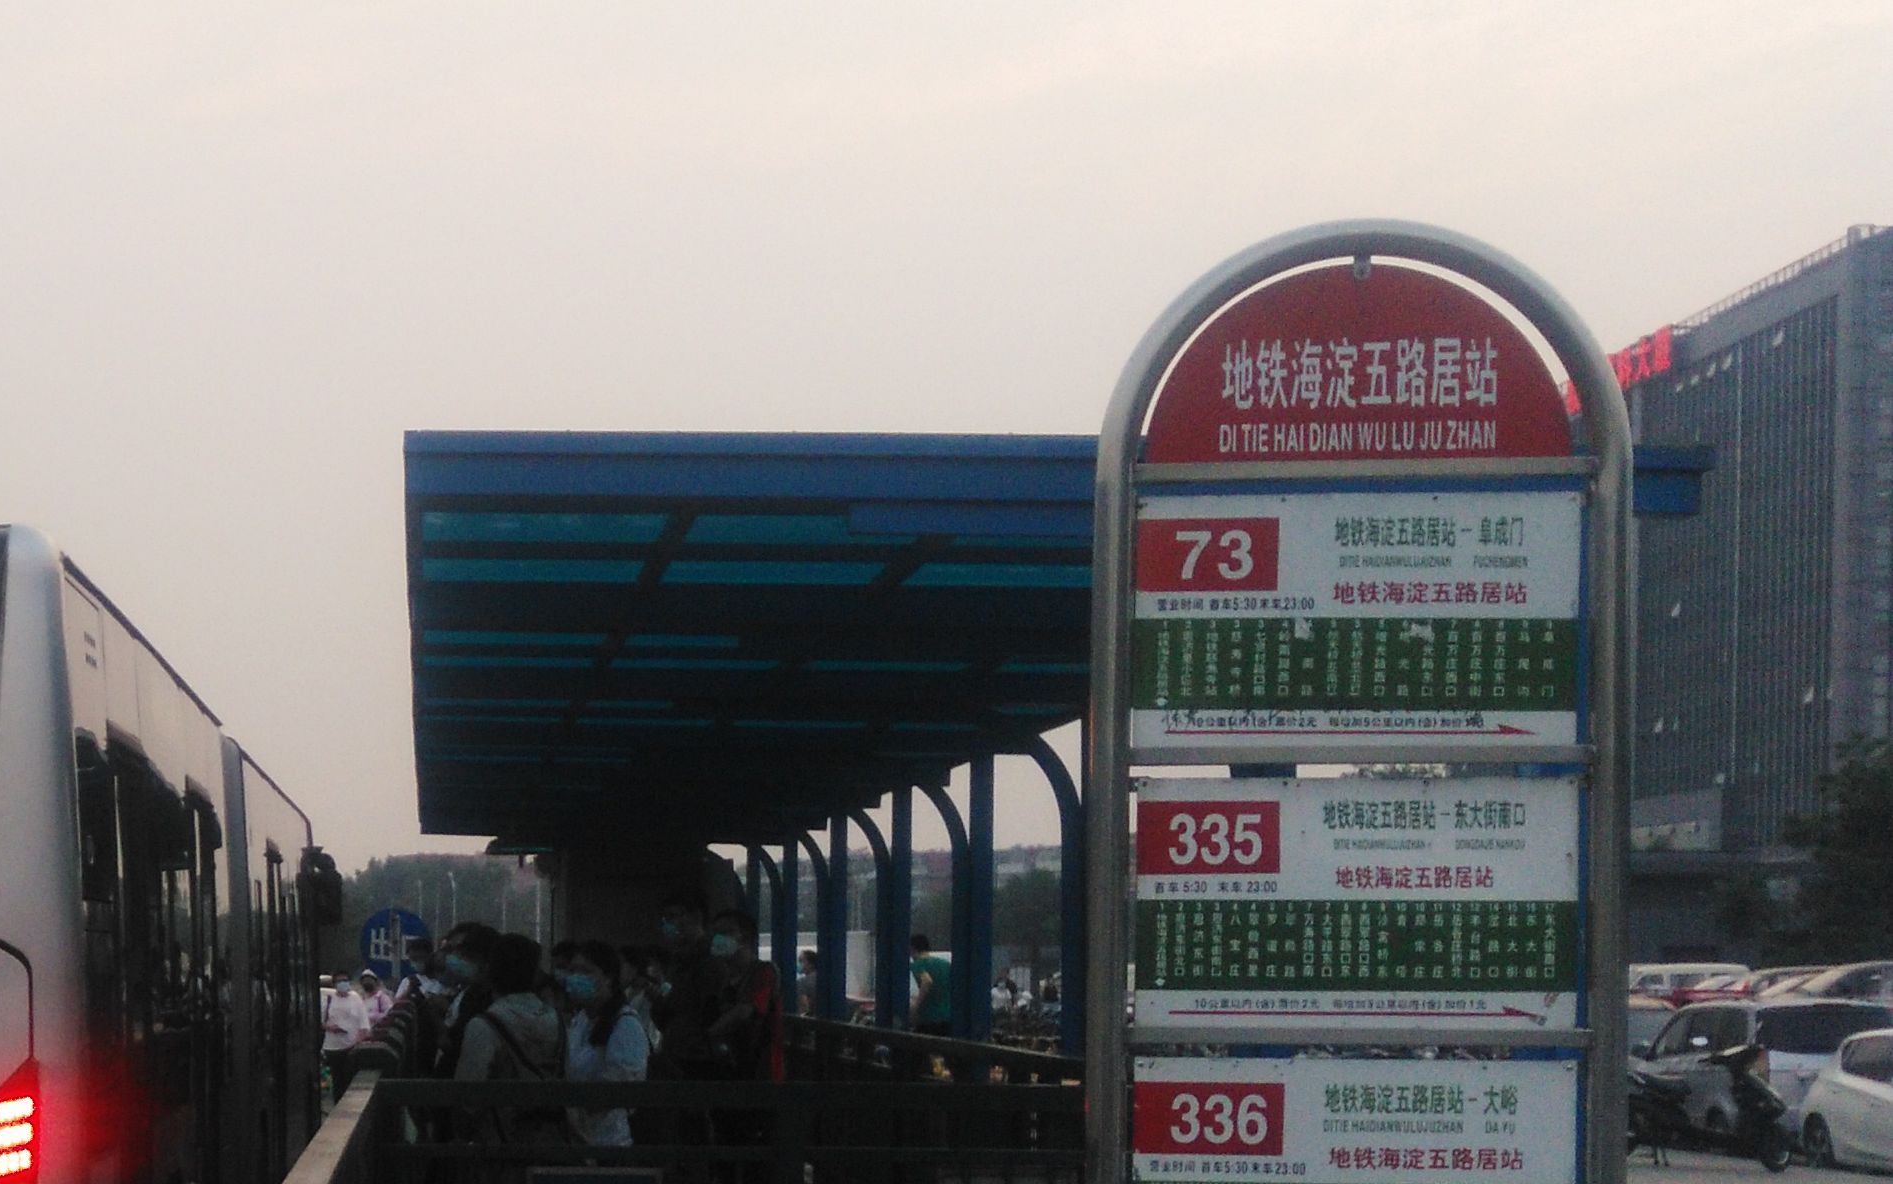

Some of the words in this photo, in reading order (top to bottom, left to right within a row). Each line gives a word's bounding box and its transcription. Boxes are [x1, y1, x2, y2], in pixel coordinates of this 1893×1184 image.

[1221, 337, 1498, 410] 地铁海淀五路居站
[1218, 424, 1238, 453] DI
[1241, 424, 1269, 453] TIE
[1273, 423, 1305, 452] HAI
[1308, 422, 1353, 451] DIAN
[1357, 422, 1387, 451] WU
[1390, 421, 1416, 450] LU
[1419, 421, 1443, 450] JU
[1446, 420, 1497, 450] ZHAN
[1334, 516, 1456, 547] 地铁海淀五路居站
[1478, 516, 1524, 547] 阜成门
[1176, 530, 1254, 580] 73
[1333, 581, 1527, 605] 地铁海淀五路居站
[1323, 801, 1437, 831] 地铁海淀五路居站
[1453, 800, 1526, 830] 东大街南口
[1168, 813, 1263, 865] 335
[1183, 881, 1207, 893] 5:30
[1247, 881, 1278, 893] 23:00
[1335, 866, 1494, 889] 地铁海淀五路居站
[1324, 1084, 1464, 1115] 地铁海淀五路居站
[1483, 1086, 1518, 1116] 大峪
[1170, 1094, 1268, 1145] 336
[1329, 1147, 1524, 1170] 地铁海淀五路居站
